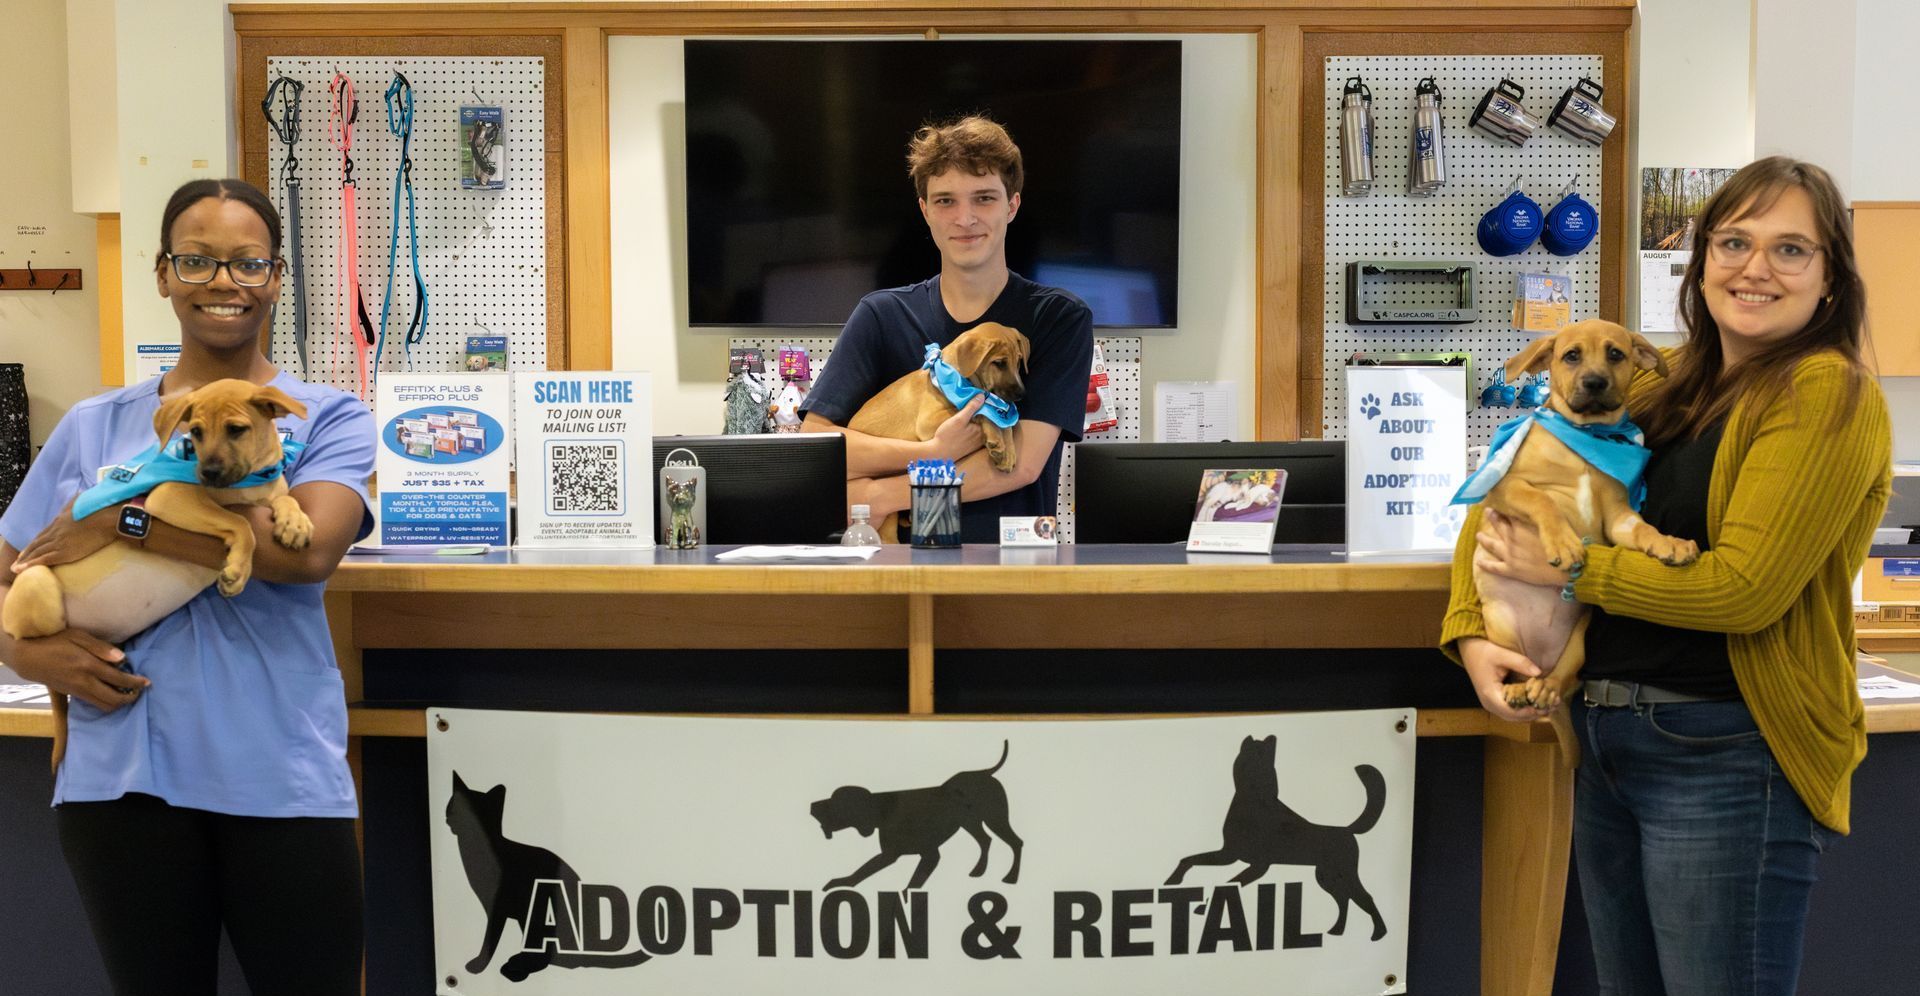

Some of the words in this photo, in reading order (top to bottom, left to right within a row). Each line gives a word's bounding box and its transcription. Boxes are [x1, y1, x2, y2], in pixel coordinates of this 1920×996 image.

[534, 381, 582, 403] SCAN
[589, 381, 632, 403] HERE
[1391, 392, 1424, 406] ASK
[547, 409, 562, 419] TO
[563, 409, 592, 421] JOIN
[597, 409, 621, 419] OUR
[543, 423, 594, 432] MAILING
[598, 423, 626, 432] LIST!
[1379, 420, 1435, 433] ABOUT
[1391, 447, 1424, 461] OUR
[1364, 474, 1450, 488] ADOPTION
[1386, 501, 1430, 515] KITS!
[522, 880, 929, 960] ADOPTION
[961, 890, 1022, 960] &
[1053, 882, 1323, 959] RETAIL
